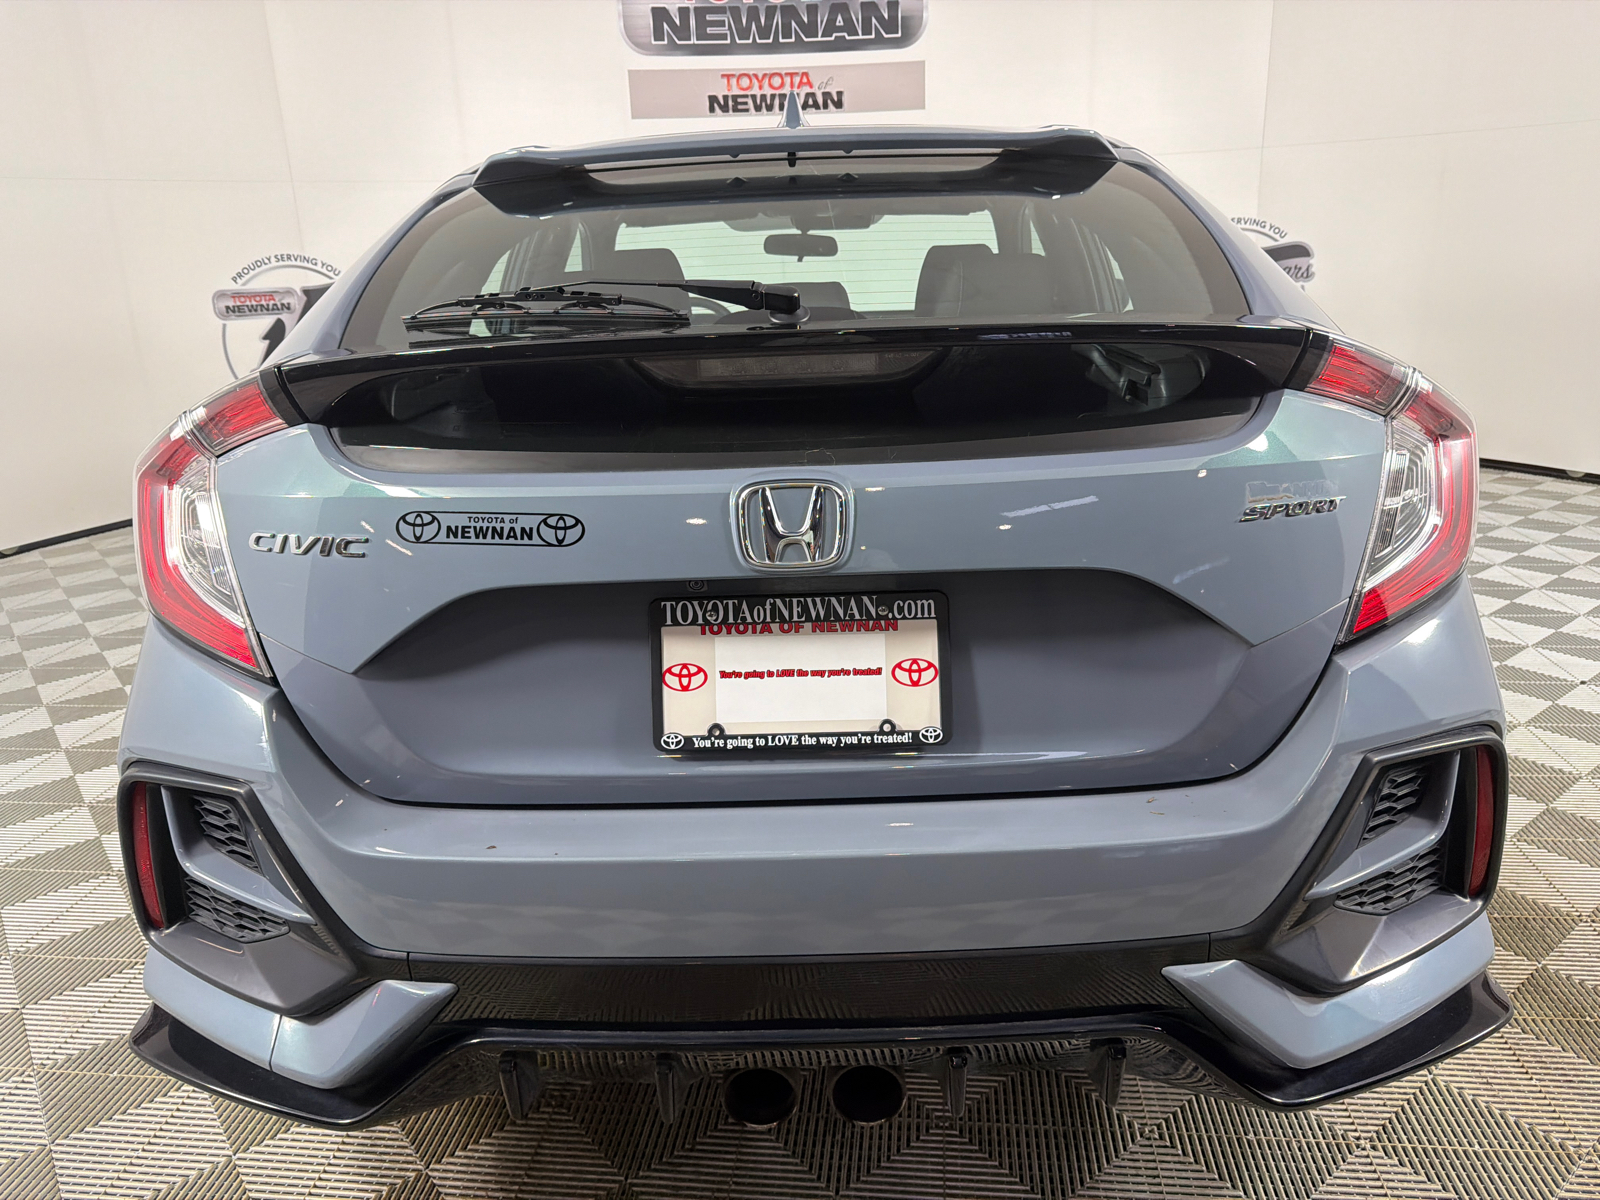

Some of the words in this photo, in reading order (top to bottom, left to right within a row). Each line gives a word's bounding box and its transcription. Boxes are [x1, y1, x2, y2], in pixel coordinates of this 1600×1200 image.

[650, 0, 902, 44] NEWNAN
[721, 71, 814, 92] TOYOTA
[817, 76, 834, 91] of
[1268, 223, 1288, 239] YOU
[231, 255, 272, 285] PROUDLY
[273, 253, 318, 267] SERVING
[320, 260, 342, 277] YOU
[230, 293, 277, 304] TOYOTA
[224, 302, 291, 315] NEWNAN
[1237, 496, 1347, 523] SPORT
[467, 516, 507, 525] TOYOTA
[508, 516, 519, 525] of
[446, 525, 534, 542] NEWNAN
[248, 532, 370, 558] CIVIC
[811, 619, 899, 633] NEWNAN
[743, 669, 766, 680] going
[766, 669, 775, 678] to
[775, 668, 795, 678] LOVE
[796, 668, 809, 677] the
[810, 669, 826, 678] way
[852, 667, 883, 676] treated!
[726, 736, 754, 750] going
[755, 737, 766, 746] to
[767, 735, 799, 746] LOVE
[801, 734, 817, 745] the
[819, 736, 839, 747] way
[873, 732, 913, 744] treated!
